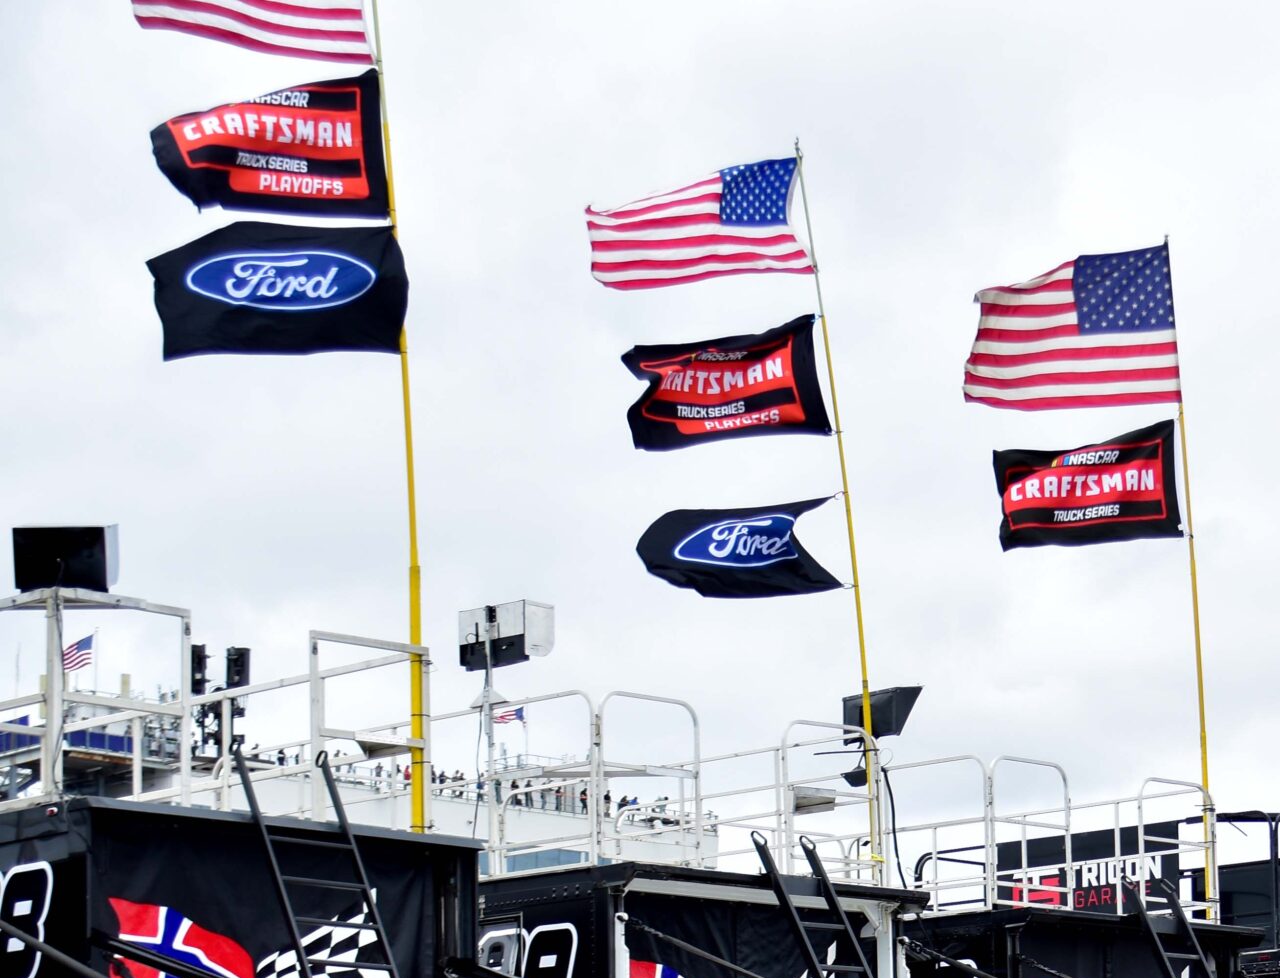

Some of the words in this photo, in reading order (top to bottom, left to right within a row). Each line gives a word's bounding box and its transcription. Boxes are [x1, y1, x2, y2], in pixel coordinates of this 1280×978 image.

[183, 112, 352, 147] CRAFTSMAN
[269, 156, 308, 173] SERIES
[259, 174, 343, 195] PLAYOFFS
[225, 257, 338, 299] Ford
[677, 404, 707, 418] TRUCK
[708, 401, 745, 418] SERIES
[1068, 450, 1119, 465] NASCAR
[1010, 469, 1154, 501] CRAFTSMAN
[1053, 509, 1083, 522] TRUCK
[1084, 504, 1120, 518] SERIES
